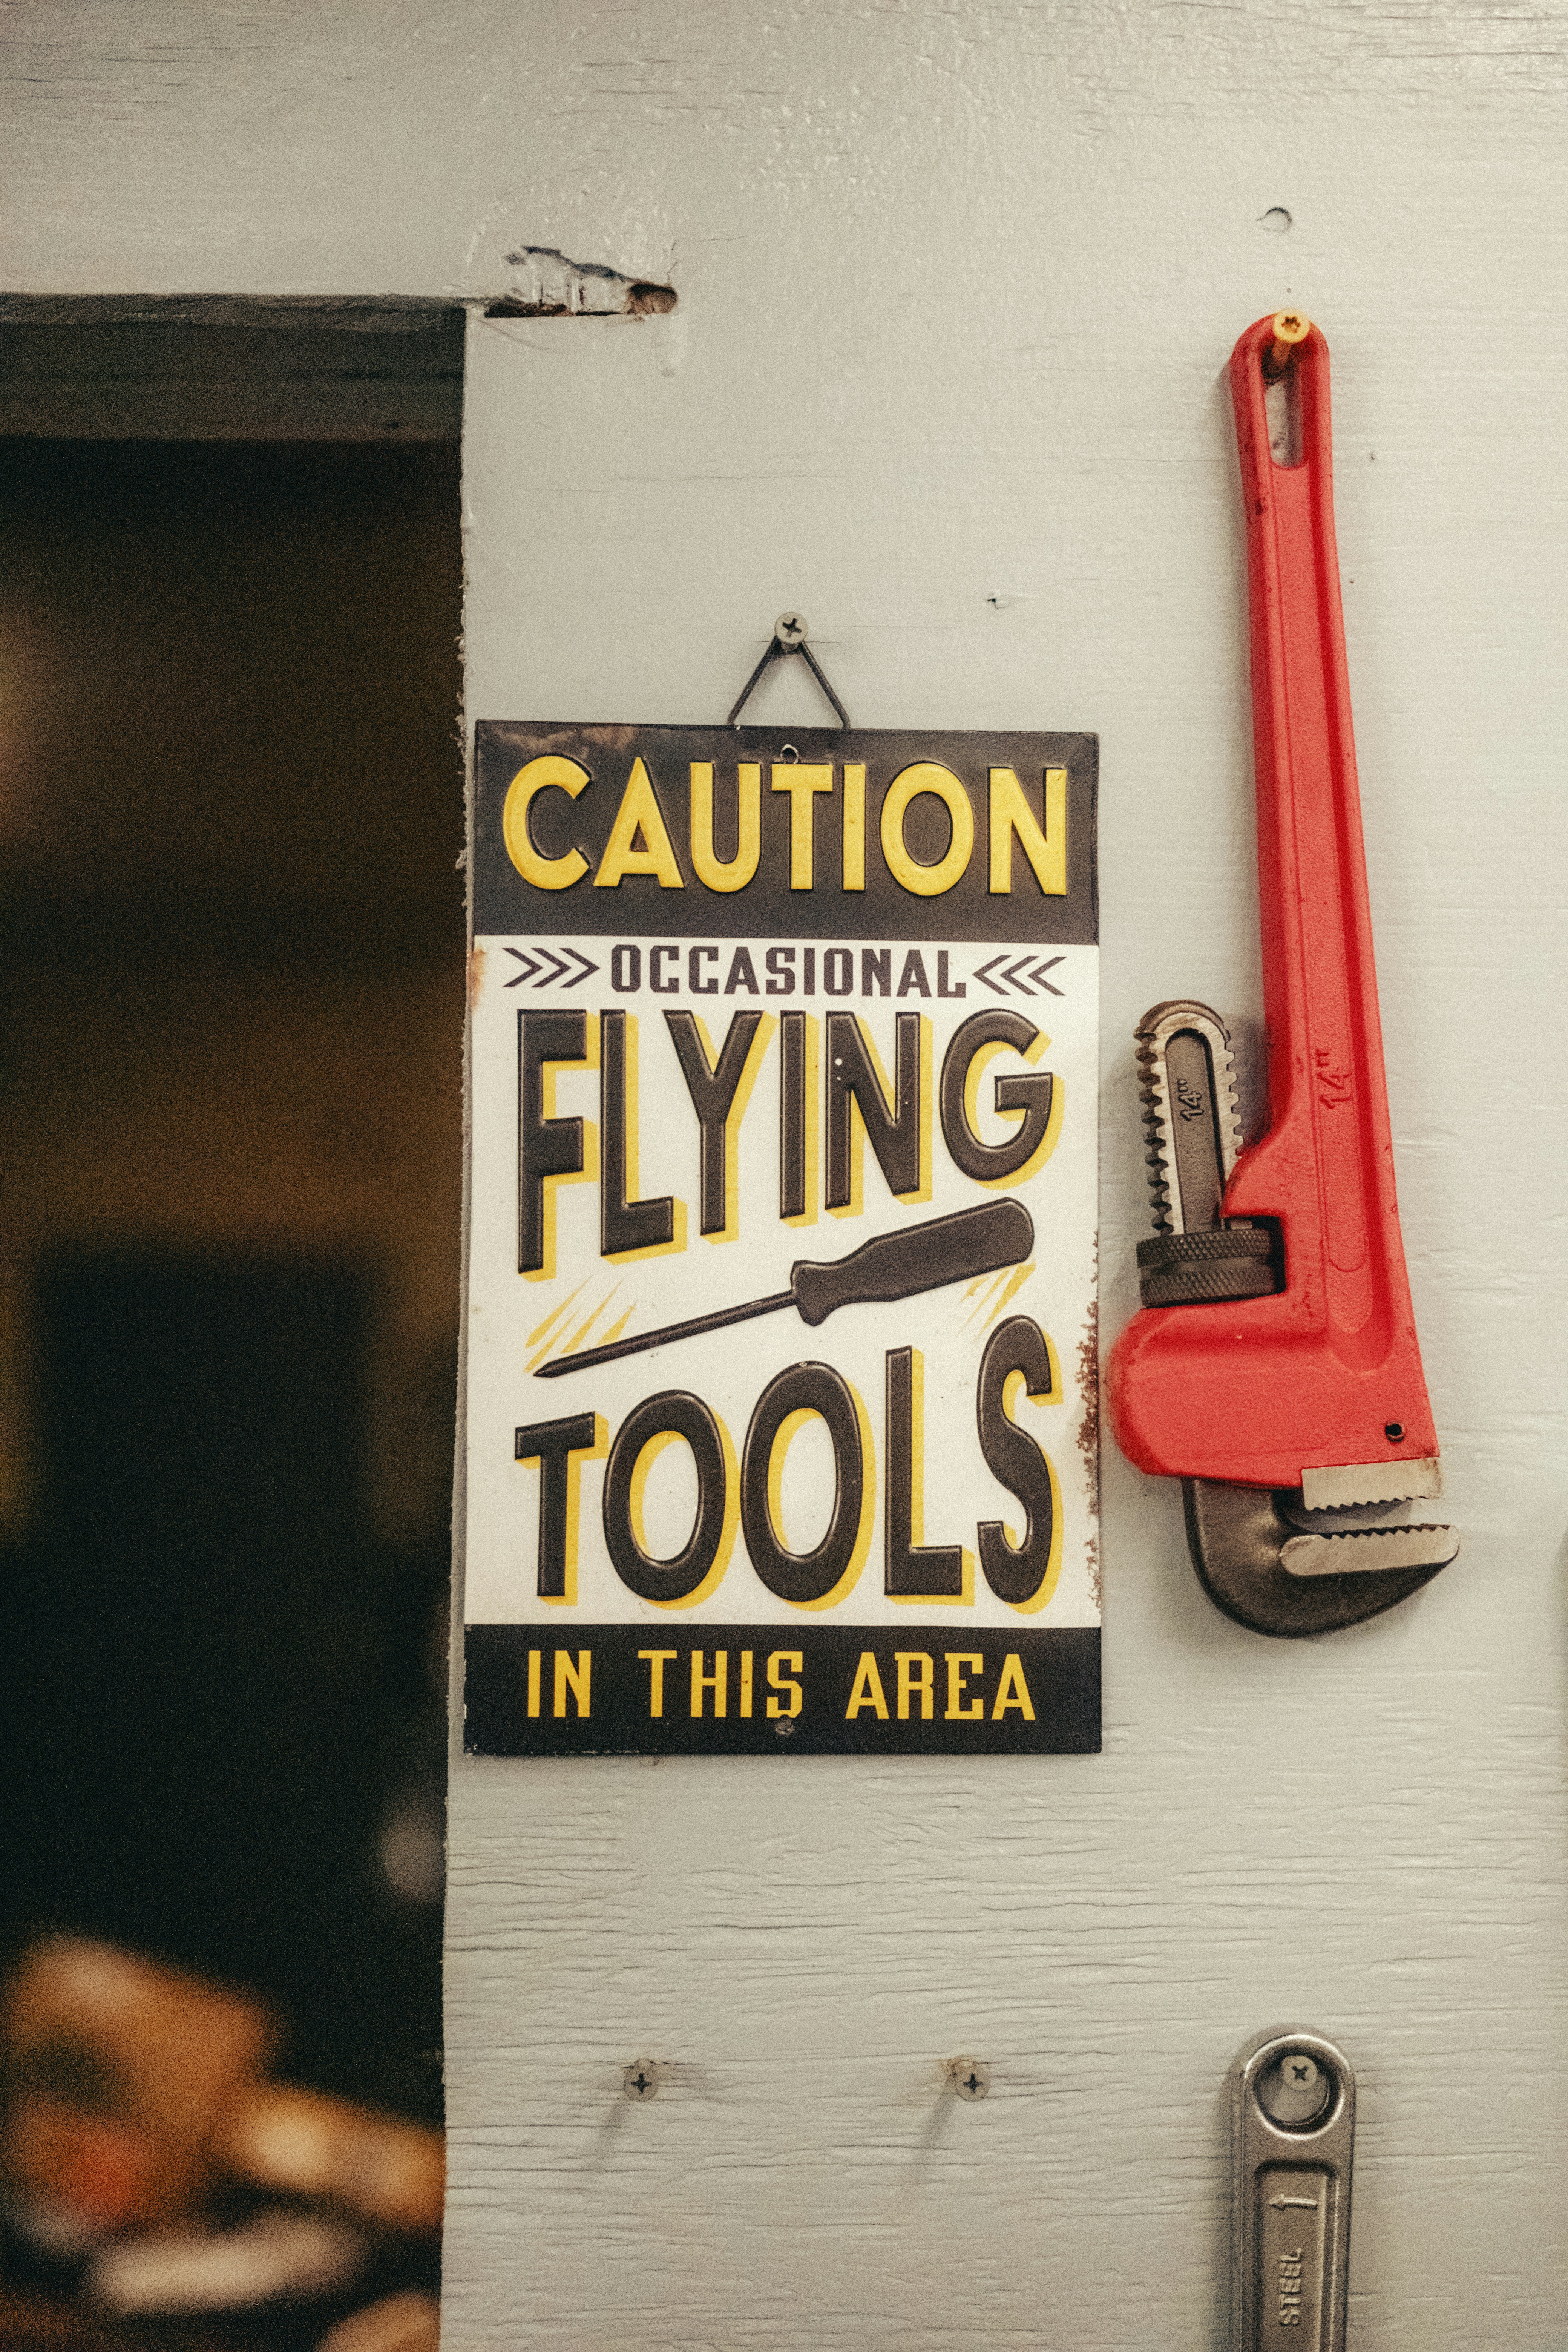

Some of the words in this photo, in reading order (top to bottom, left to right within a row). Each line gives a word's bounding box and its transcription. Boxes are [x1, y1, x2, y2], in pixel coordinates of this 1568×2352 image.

[503, 755, 1067, 897] CAUTION
[611, 944, 966, 998] OCCASIONAL
[517, 1009, 1063, 1280] FLYING
[515, 1315, 1064, 1615] TOOLS
[527, 1650, 592, 1718] IN
[638, 1650, 803, 1718] THIS
[845, 1651, 1036, 1720] AREA
[1279, 2248, 1302, 2327] STEEL
